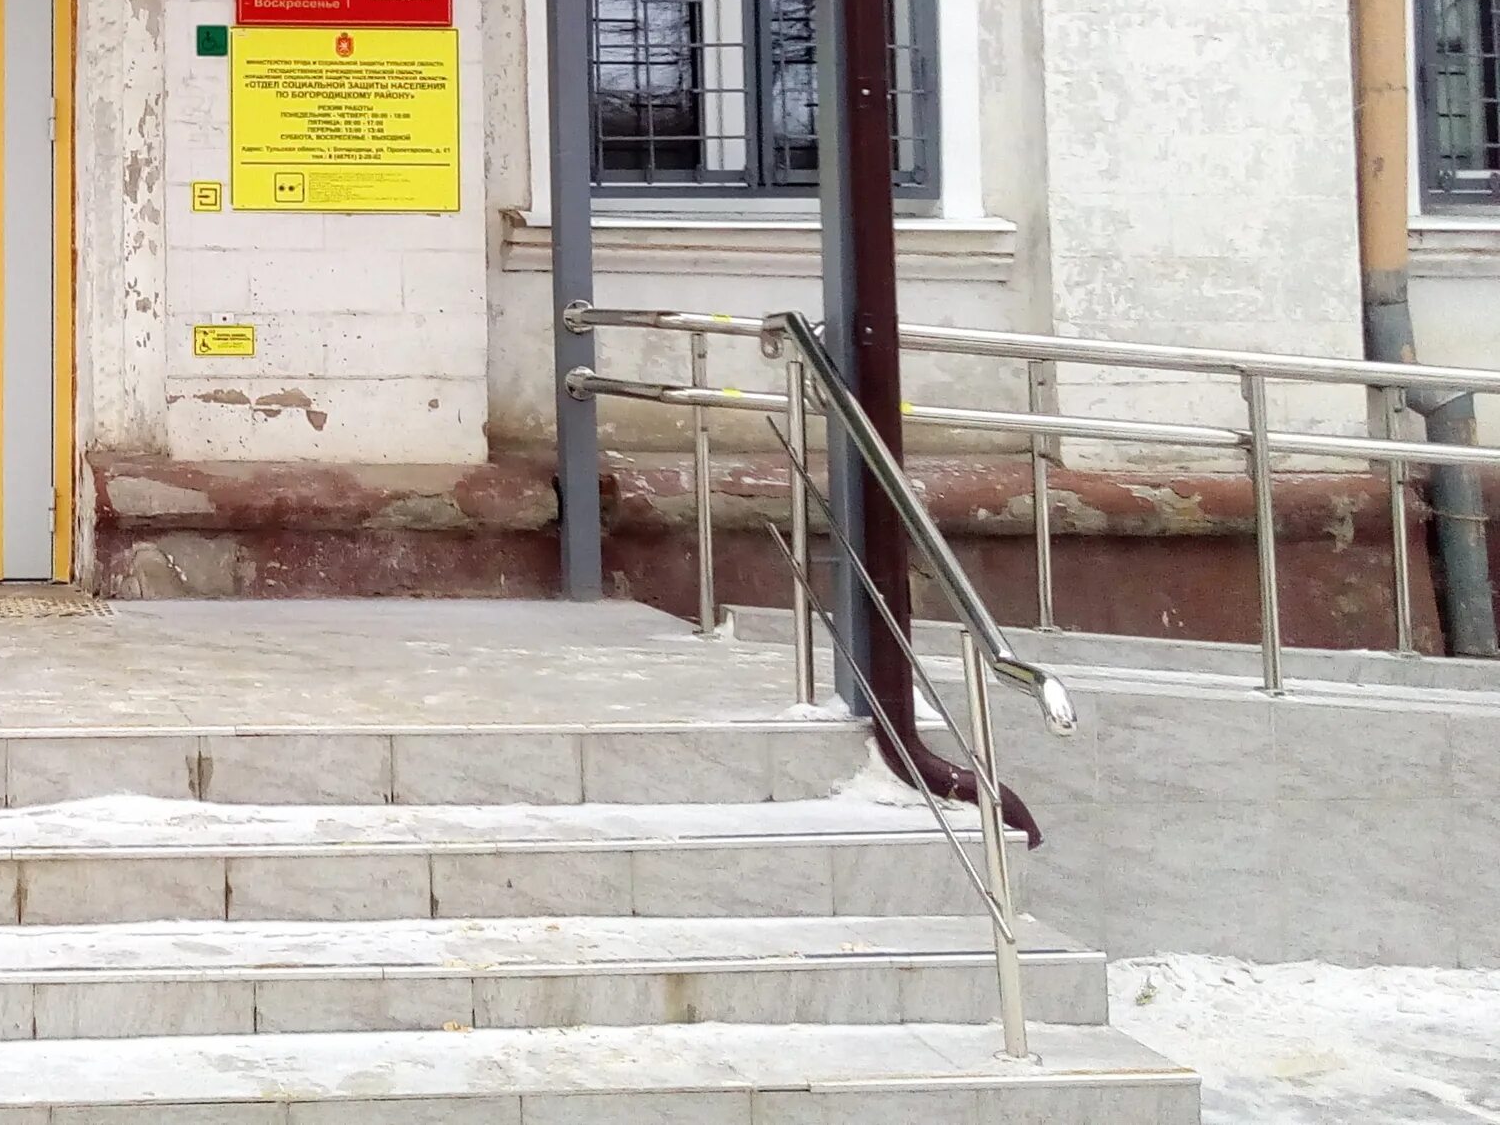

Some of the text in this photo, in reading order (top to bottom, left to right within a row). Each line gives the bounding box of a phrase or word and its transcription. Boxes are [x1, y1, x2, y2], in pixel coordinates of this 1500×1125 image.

[281, 80, 345, 89] СОЦИАЛЬНОЙ
[348, 81, 388, 90] ЗАЩИТЫ
[390, 82, 446, 90] НАСЕЛЕНИЯ
[291, 91, 371, 99] БОГОРОДИЦКОМУ
